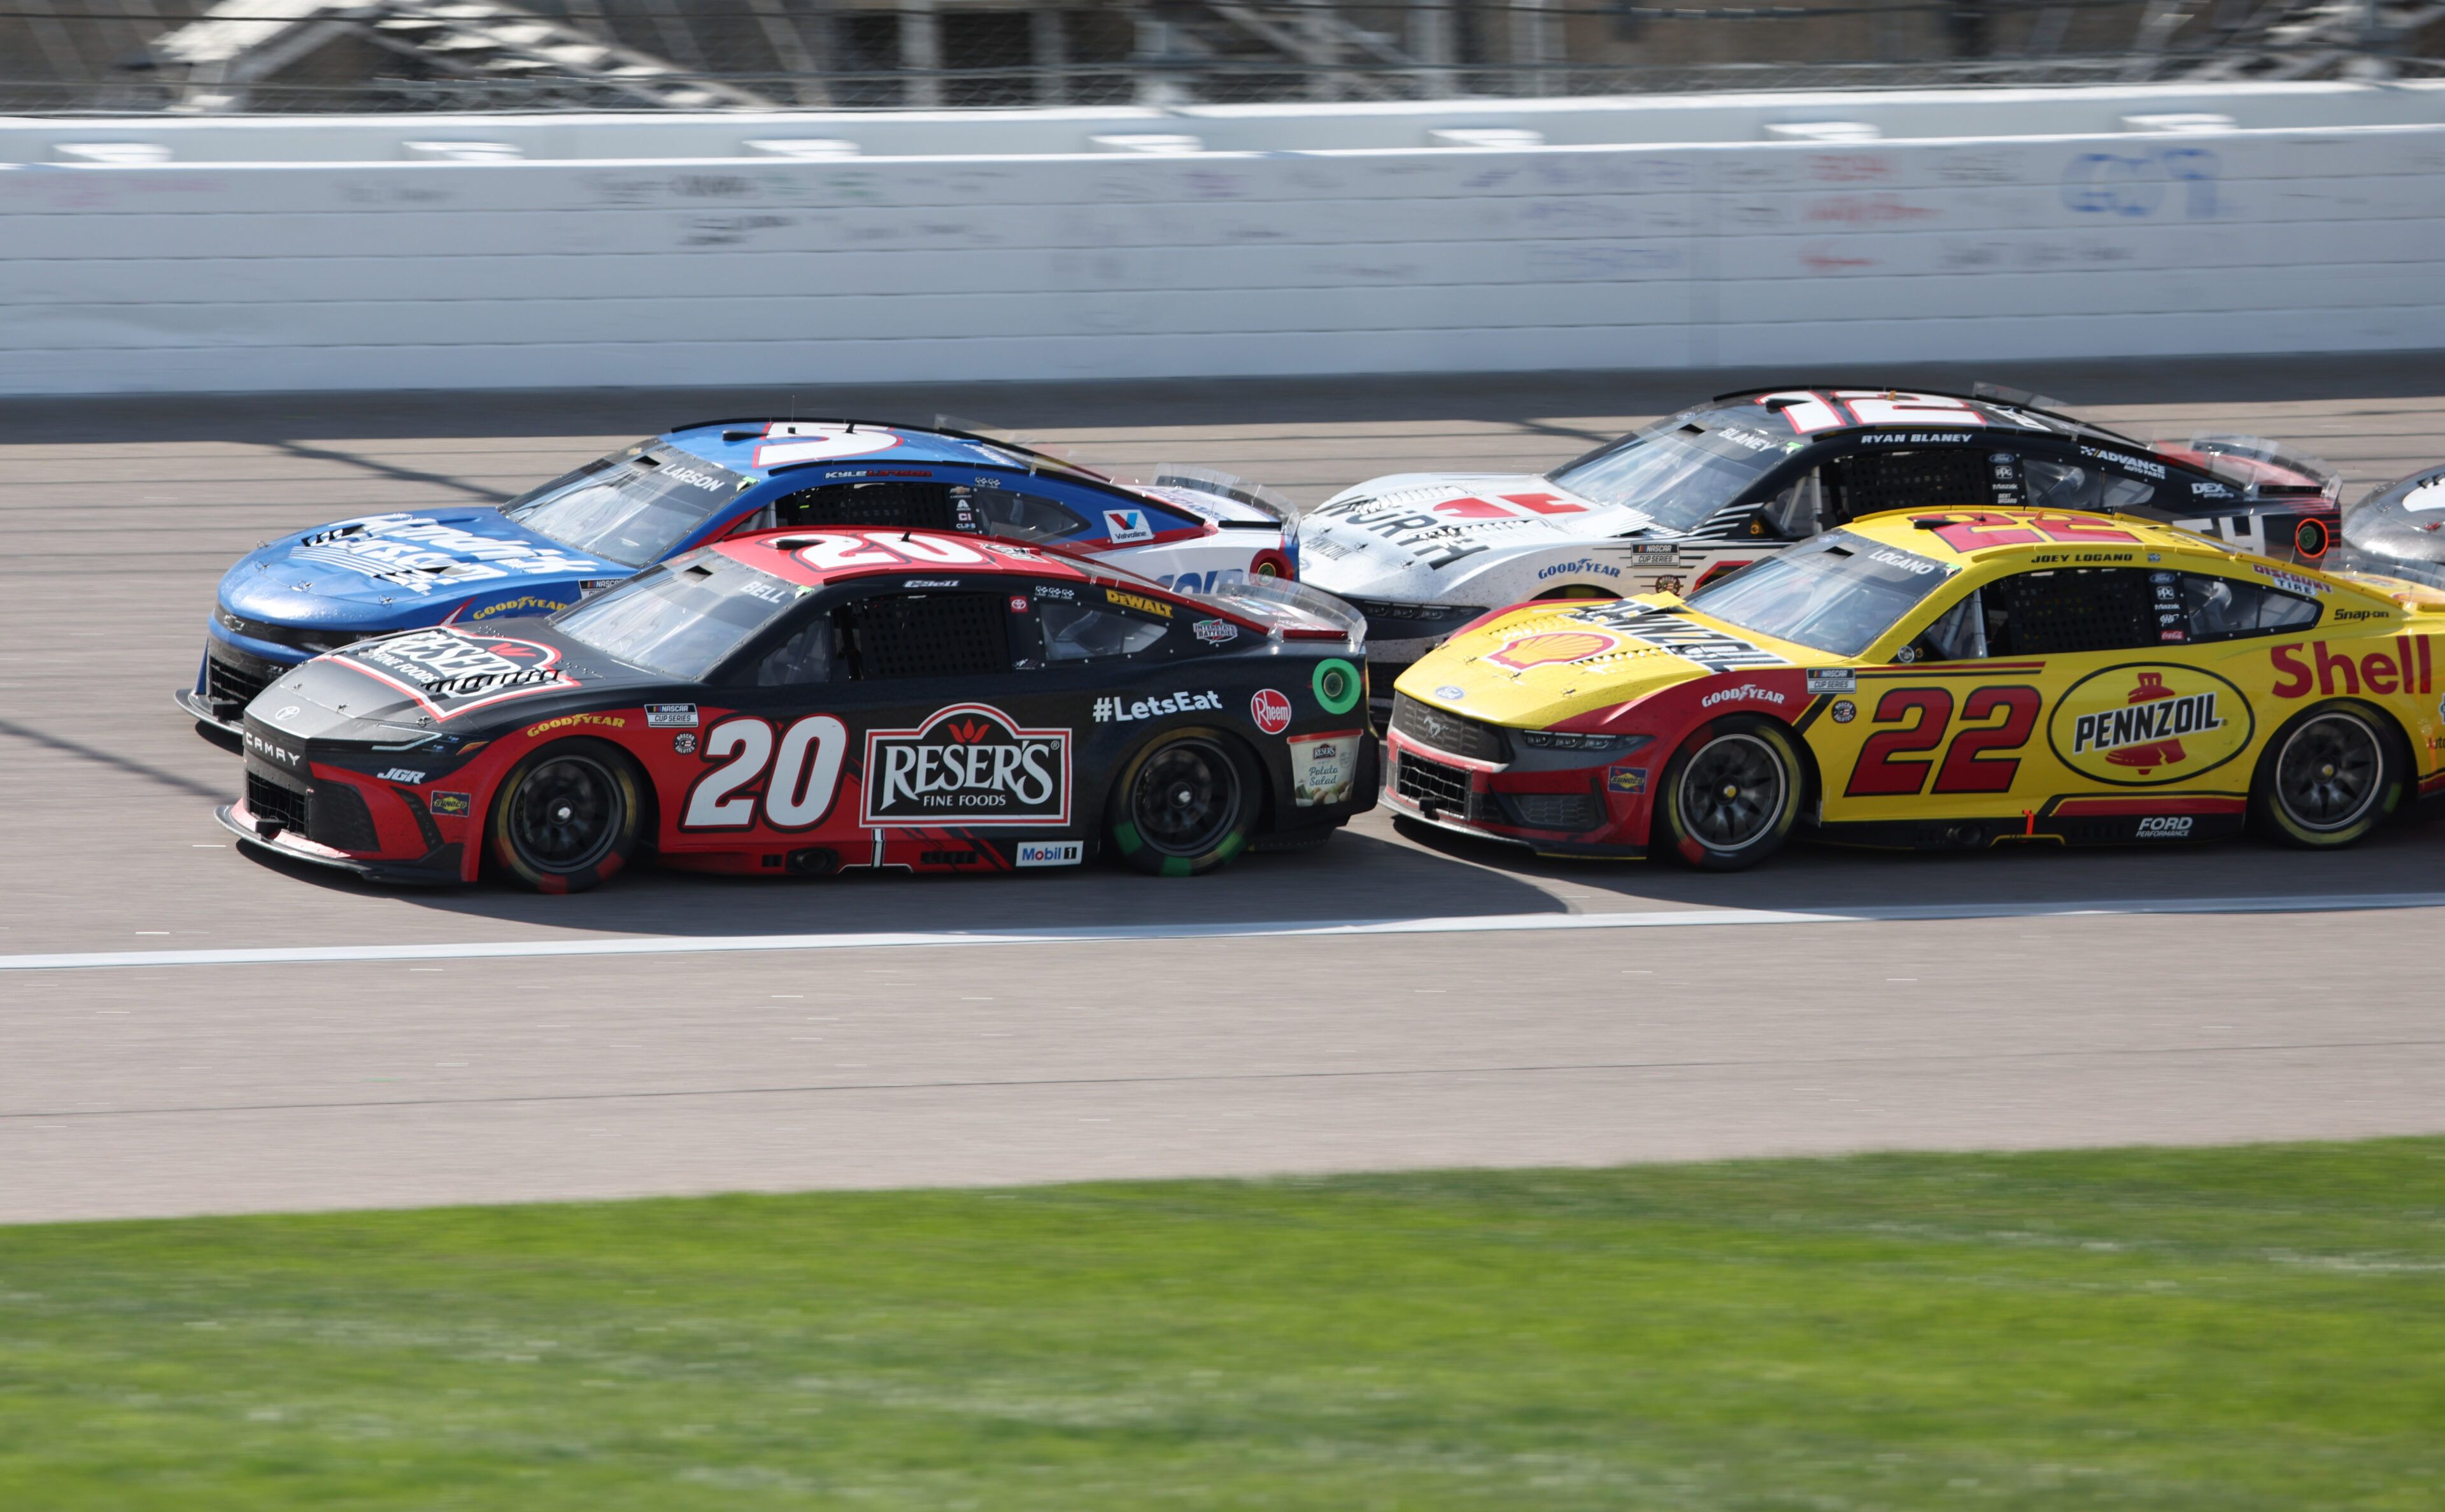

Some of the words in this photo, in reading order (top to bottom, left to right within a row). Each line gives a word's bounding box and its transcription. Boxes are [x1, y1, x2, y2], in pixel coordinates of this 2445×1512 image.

[1755, 390, 1987, 434] 12
[1718, 428, 1776, 452] BLANEY
[1861, 434, 1906, 444] RYAN
[1911, 434, 1973, 443] BLANEY
[2097, 451, 2165, 474] ADVANCE
[2123, 465, 2143, 474] AUTO
[2144, 469, 2165, 479] PARTS
[660, 463, 725, 492] LARSON
[2191, 483, 2227, 494] DEX
[1115, 531, 1147, 540] Valvoline
[1906, 511, 2143, 553] 22
[757, 530, 995, 572] 20
[2031, 554, 2070, 563] JOEY
[2074, 554, 2133, 562] LOGANO
[1538, 558, 1620, 579] GOODYEAR
[1867, 549, 1934, 576] LOGANO
[2252, 564, 2333, 593] DISCOUNT
[2276, 579, 2312, 595] TIRE
[740, 580, 786, 604] BELL
[2334, 609, 2390, 621] Snap-on
[1198, 629, 1238, 637] BATTERIES
[2271, 634, 2432, 698] Shell
[1701, 684, 1785, 707] GOODYEAR
[1093, 690, 1222, 723] #LetsEat
[1255, 691, 1289, 726] Rheem
[527, 713, 626, 737] GOODYEAR
[2074, 693, 2221, 754] PENNZOIL
[676, 733, 695, 741] NASCAR
[1843, 684, 2043, 797] 22
[246, 731, 301, 766] CAMRY
[675, 745, 695, 753] SALUTES
[377, 768, 426, 784] JGR
[684, 714, 847, 827] 20
[1309, 765, 1339, 776] Potato
[1309, 775, 1336, 786] Salad
[1611, 776, 1645, 785] SUNOCO
[434, 798, 467, 809] SUNOCO
[924, 795, 953, 807] FINE
[959, 795, 1006, 807] FOODS
[2138, 817, 2193, 830] FORD
[1022, 847, 1061, 861] Mobil
